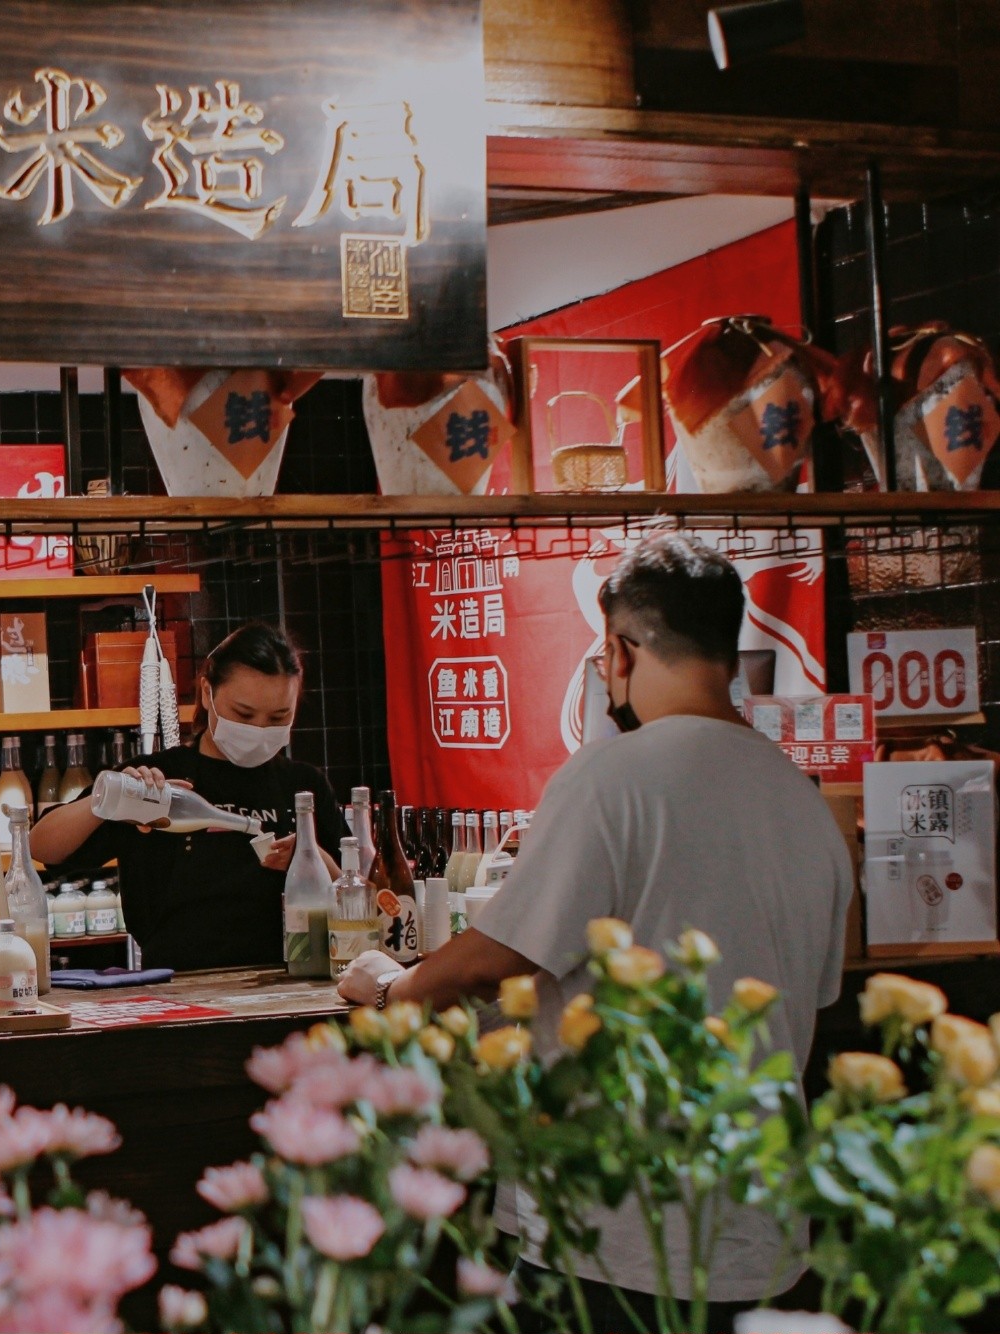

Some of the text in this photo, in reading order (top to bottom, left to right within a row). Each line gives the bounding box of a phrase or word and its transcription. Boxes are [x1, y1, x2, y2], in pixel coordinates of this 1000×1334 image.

[225, 390, 273, 444] 钱
[445, 409, 491, 462] 钱
[760, 403, 800, 451] 钱
[946, 403, 984, 453] 钱
[412, 562, 430, 587] 江
[431, 593, 506, 641] 米造局
[437, 667, 498, 698] 鱼米香
[439, 707, 501, 739] 江南造
[783, 744, 849, 764] 迎品尝
[384, 909, 419, 951] 梅
